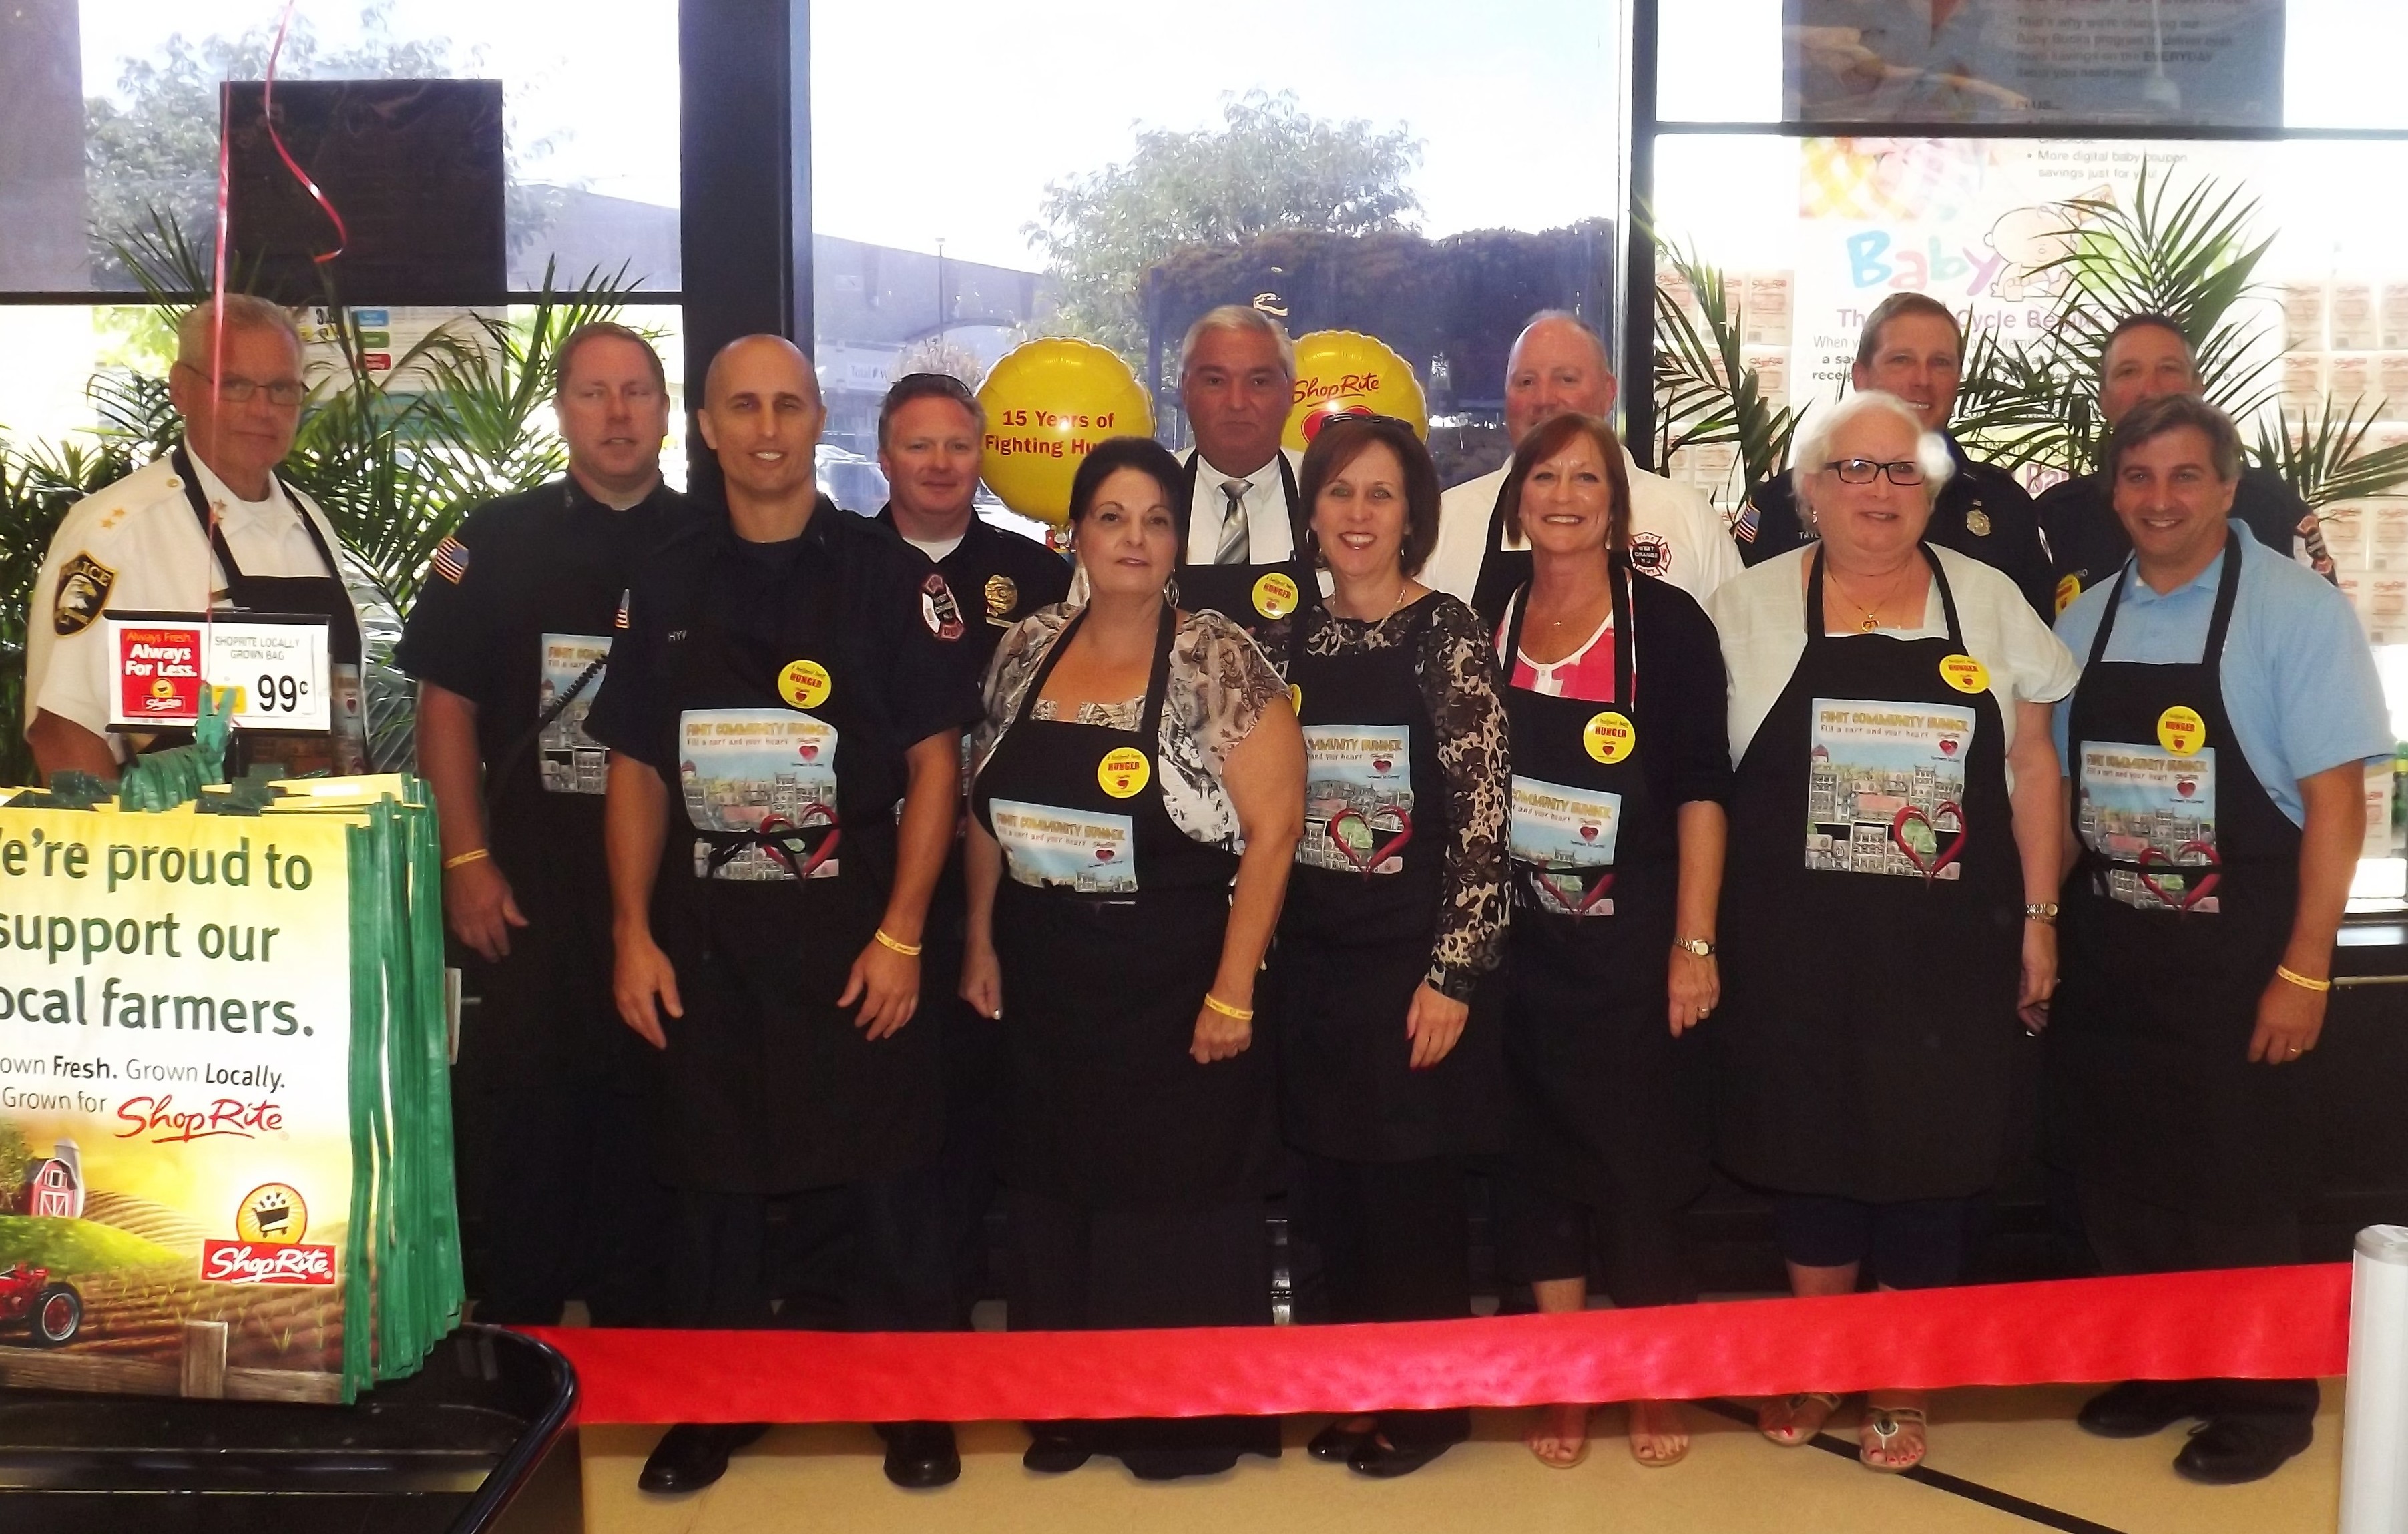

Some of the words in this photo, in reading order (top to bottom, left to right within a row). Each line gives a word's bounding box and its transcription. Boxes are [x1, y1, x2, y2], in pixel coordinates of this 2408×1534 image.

[1846, 230, 2000, 296] Baby
[1292, 372, 1380, 407] ShopRite
[1002, 409, 1027, 426] 15
[1035, 410, 1090, 427] Years
[1096, 412, 1115, 428] of
[985, 434, 1064, 458] Fighting
[129, 643, 192, 664] Always
[230, 650, 264, 660] GROWN
[266, 650, 284, 660] BAG
[260, 637, 300, 648] LOCALLY
[125, 660, 154, 676] For
[157, 661, 198, 677] Less.
[1595, 726, 1627, 738] HUNGER
[0, 827, 89, 879] e're
[107, 836, 251, 893] proud
[264, 843, 313, 891] to
[0, 912, 182, 965] support
[198, 922, 280, 963] our
[0, 976, 88, 1025] ocal
[102, 977, 314, 1037] farmers.
[0, 1057, 45, 1075] own
[53, 1055, 118, 1080] Fresh.
[126, 1059, 198, 1082] Grown
[205, 1062, 286, 1092] Locally.
[2, 1086, 71, 1111] Grown
[77, 1091, 108, 1113] for
[113, 1094, 284, 1143] ShopRite
[207, 1246, 330, 1284] ShopRite
